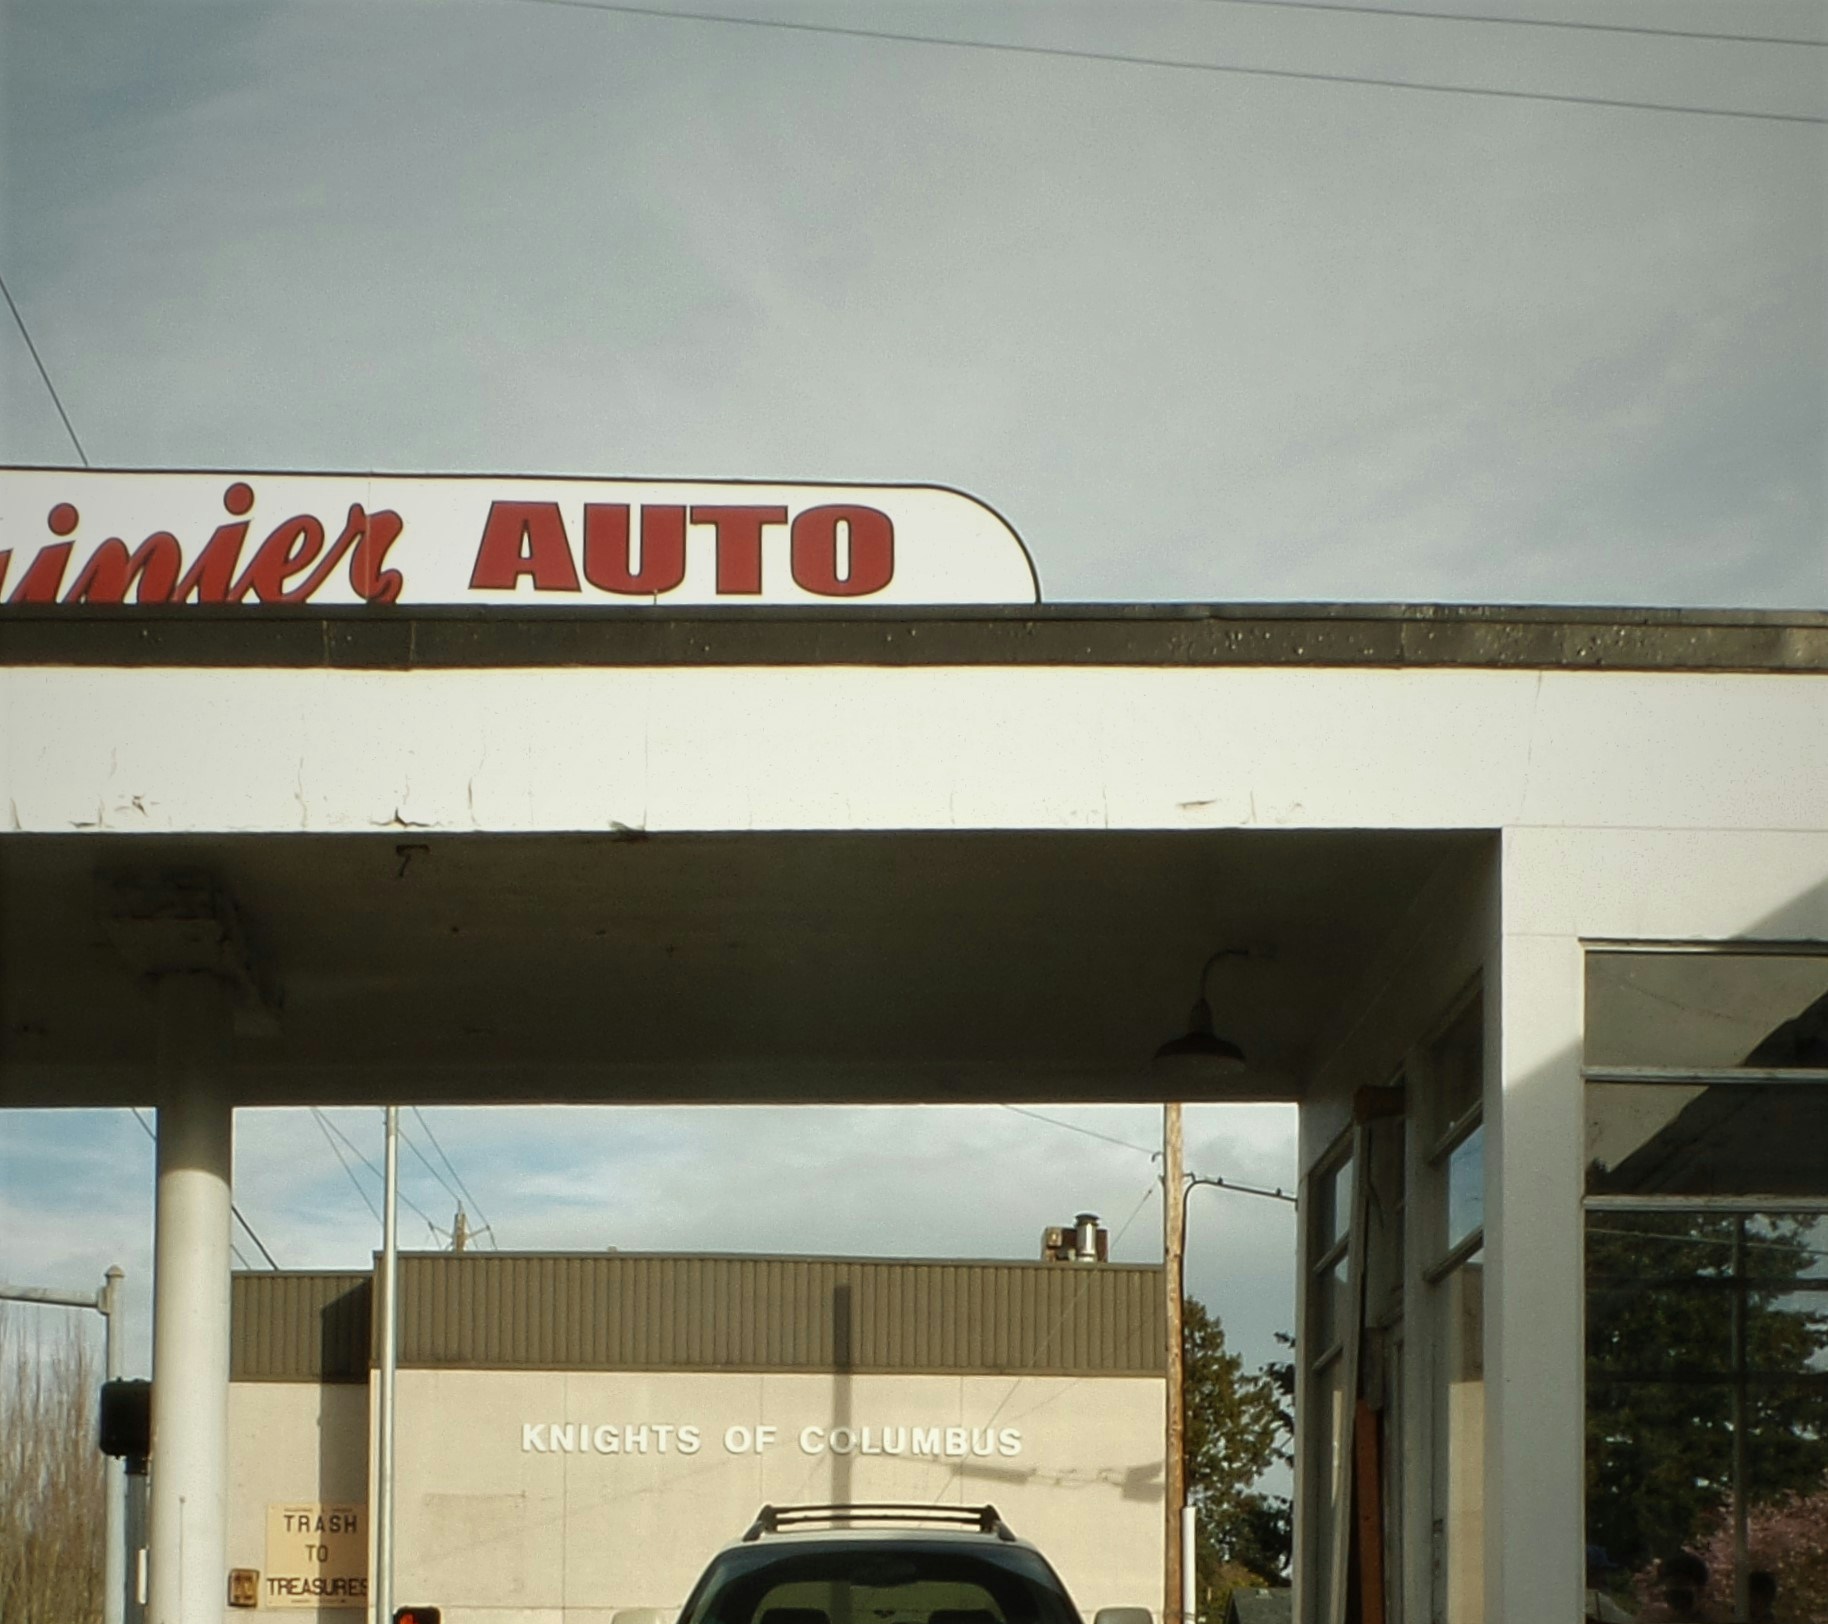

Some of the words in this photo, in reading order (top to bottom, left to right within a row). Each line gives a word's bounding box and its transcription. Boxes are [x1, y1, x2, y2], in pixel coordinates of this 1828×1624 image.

[0, 481, 404, 605] inier
[469, 499, 895, 596] AUTO
[521, 1422, 702, 1454] KNIGHTS
[723, 1424, 777, 1454] OF
[800, 1425, 1023, 1457] COLUMBUS
[283, 1514, 357, 1534] TRASH
[305, 1544, 329, 1563] TO
